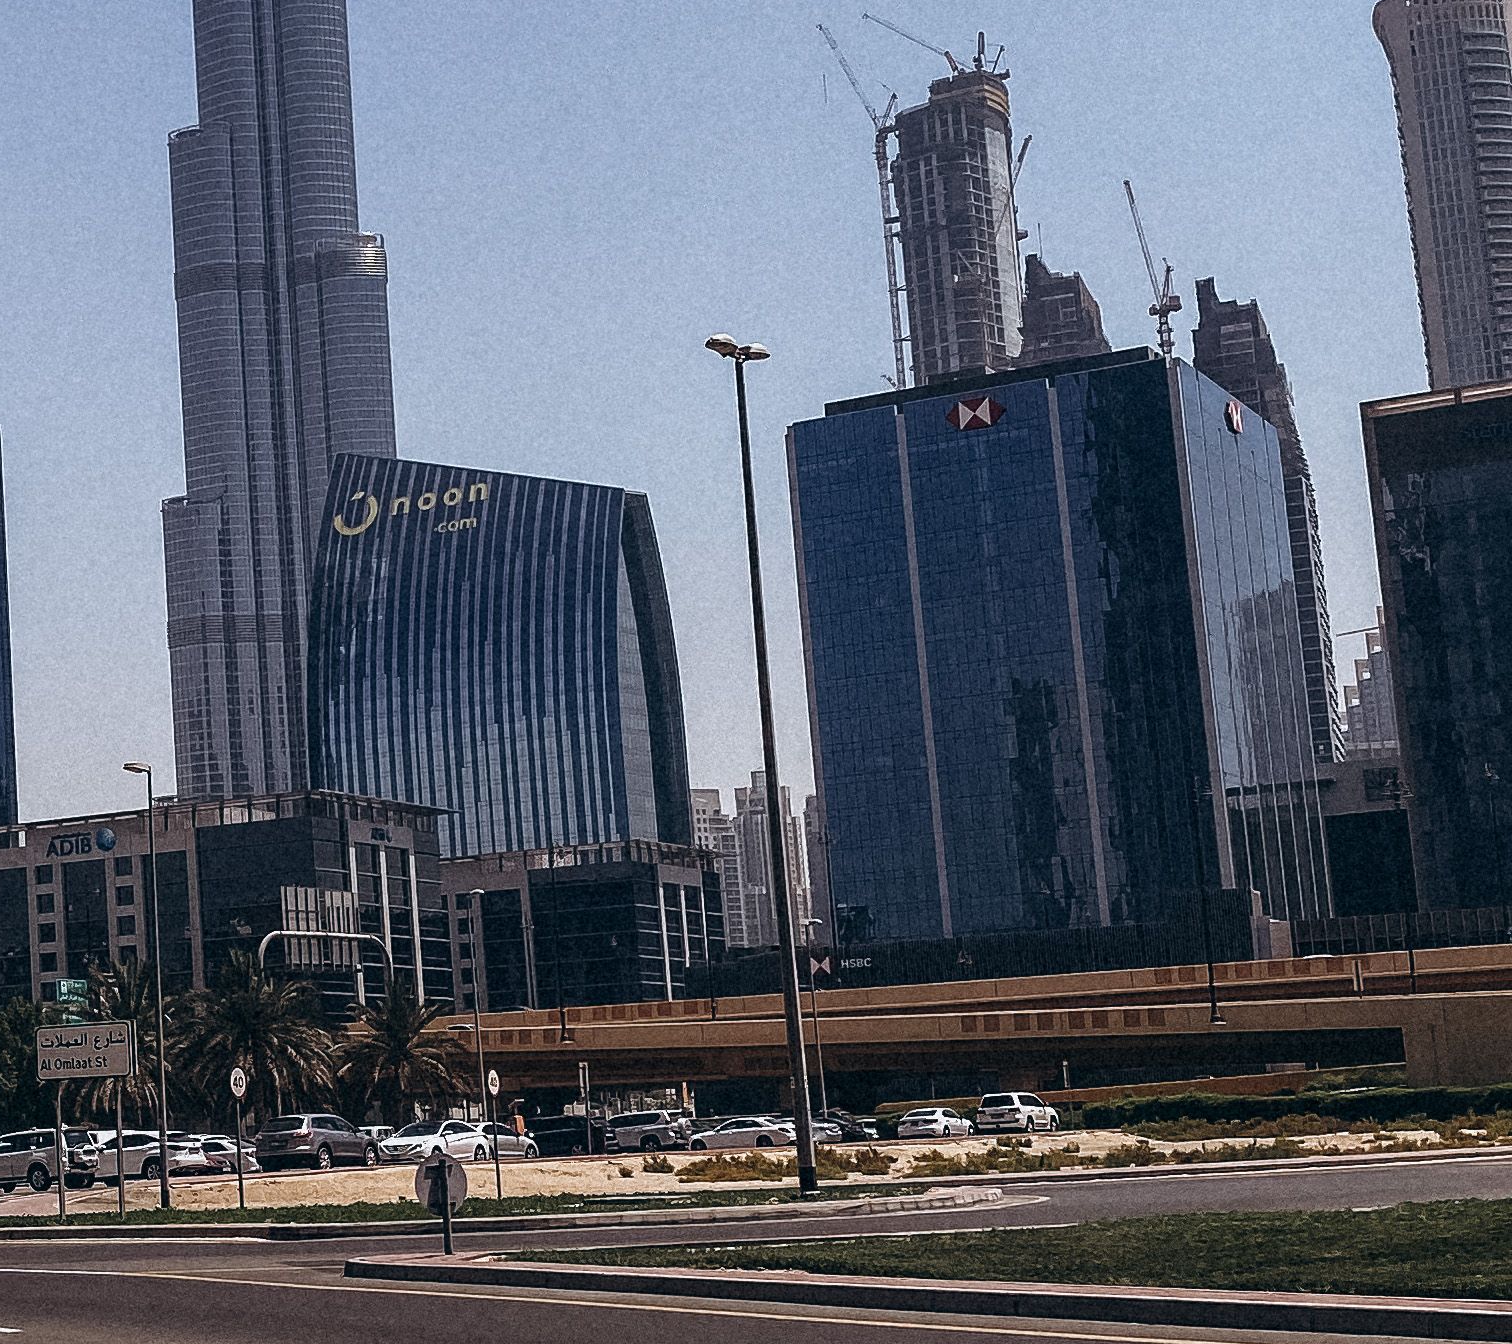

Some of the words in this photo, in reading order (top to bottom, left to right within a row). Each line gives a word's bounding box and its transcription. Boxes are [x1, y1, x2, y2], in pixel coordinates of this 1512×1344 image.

[390, 482, 489, 517] noon
[433, 517, 478, 534] .com
[46, 837, 93, 858] ADIB
[840, 957, 873, 969] HSBC
[40, 1032, 88, 1049] العملات
[93, 1030, 126, 1051] شارع
[40, 1058, 52, 1072] Al
[54, 1056, 93, 1071] Omlaat
[95, 1056, 109, 1068] St
[232, 1075, 244, 1088] 40
